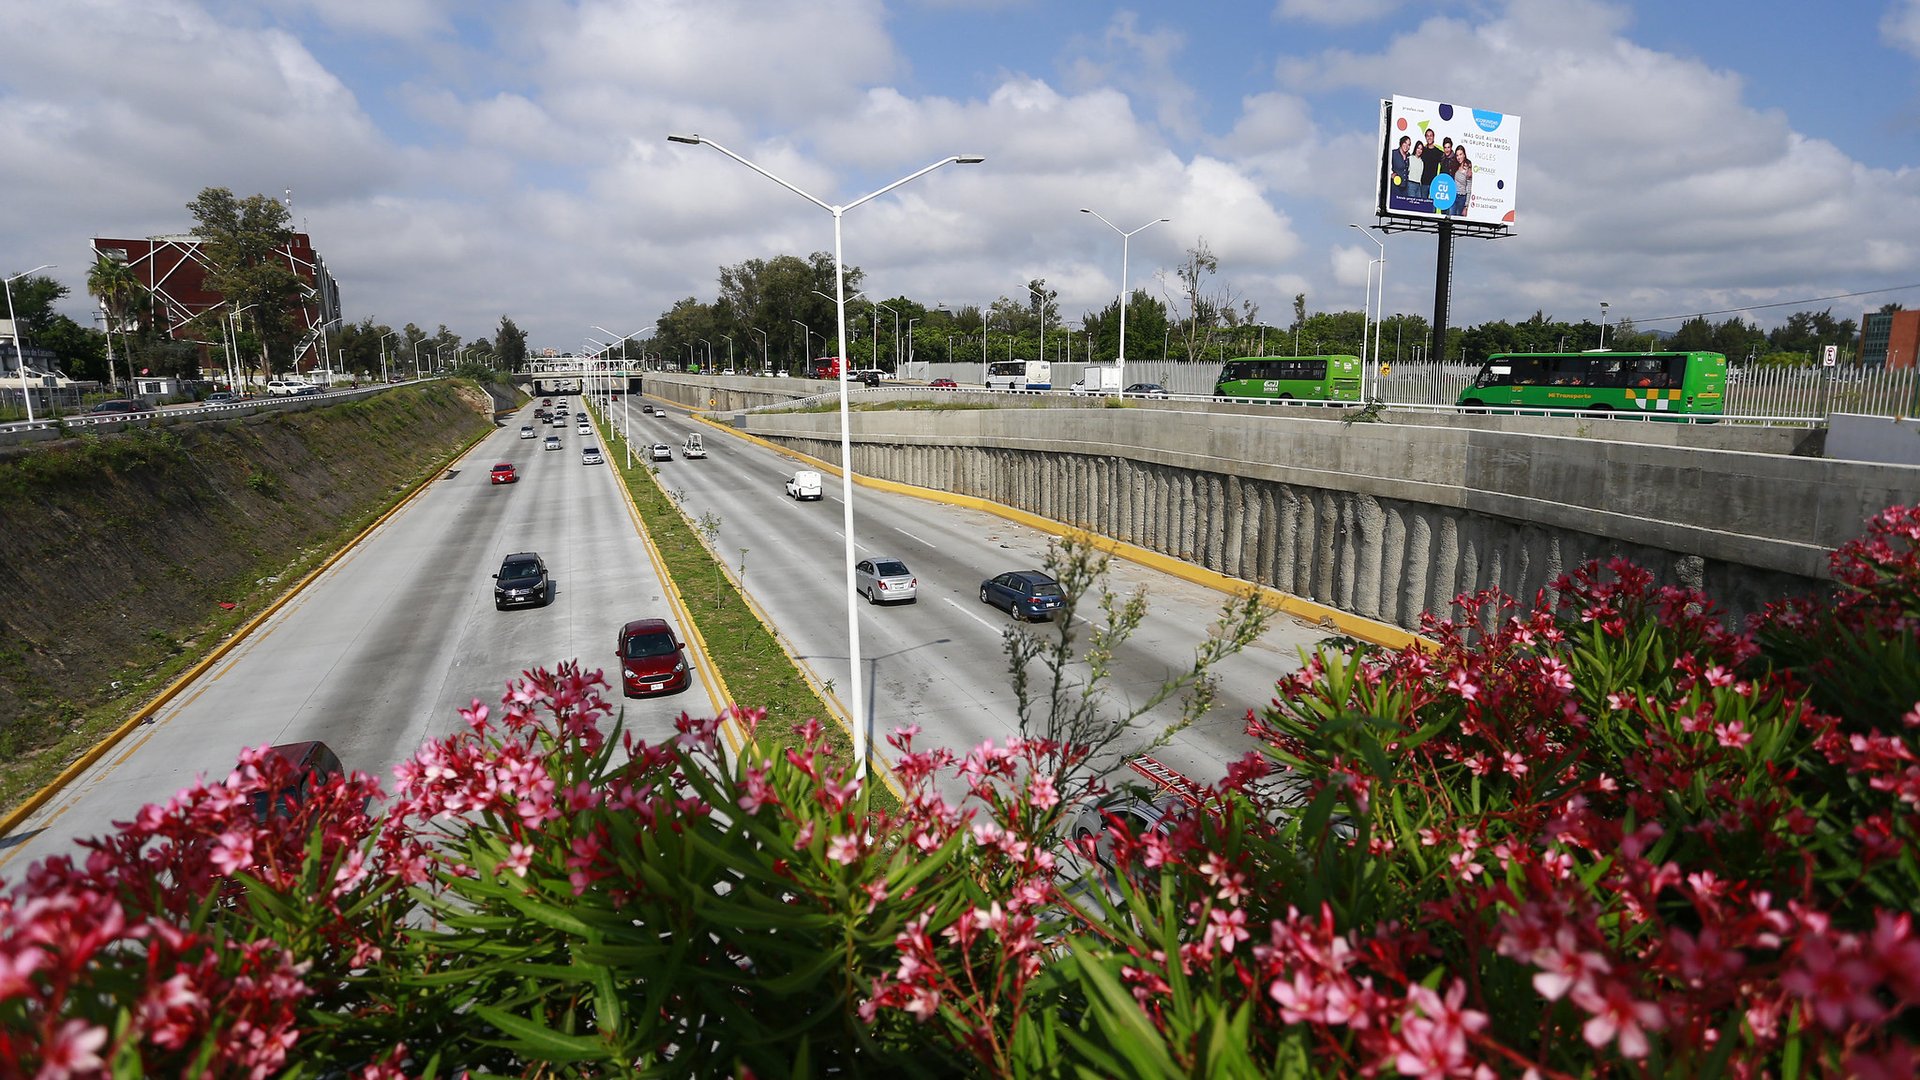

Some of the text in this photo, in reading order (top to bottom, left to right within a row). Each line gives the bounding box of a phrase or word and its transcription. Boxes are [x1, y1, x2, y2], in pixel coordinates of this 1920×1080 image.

[1493, 143, 1511, 151] AMIGOS
[1438, 184, 1448, 192] CU
[1435, 192, 1449, 201] CEA
